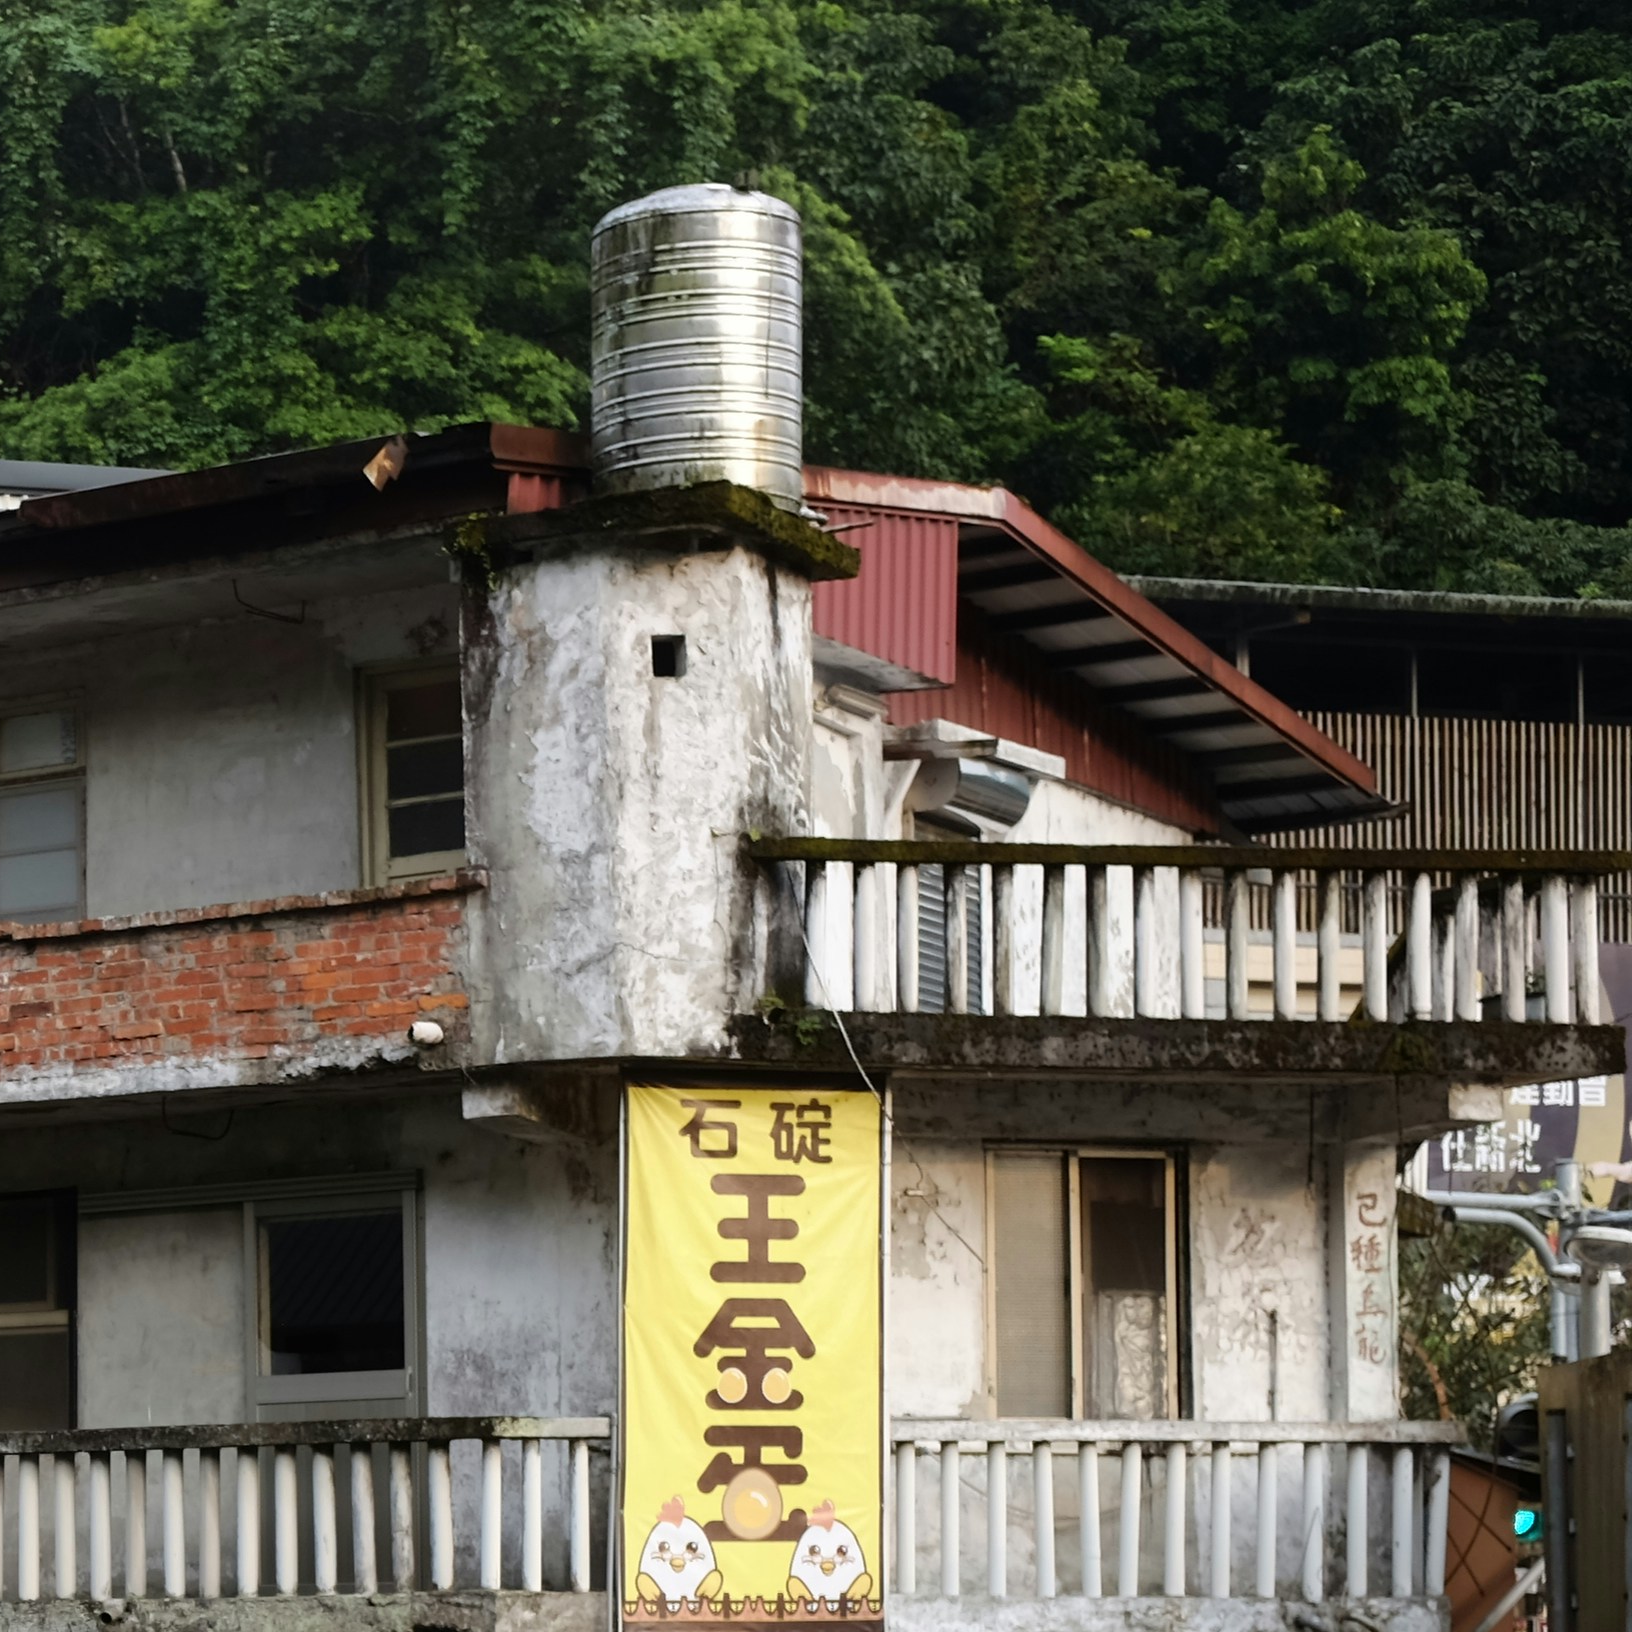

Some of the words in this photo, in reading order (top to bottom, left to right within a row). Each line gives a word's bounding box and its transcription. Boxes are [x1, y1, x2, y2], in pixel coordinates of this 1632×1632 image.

[679, 1098, 833, 1164] 石碇
[693, 1173, 816, 1542] 王金蛋
